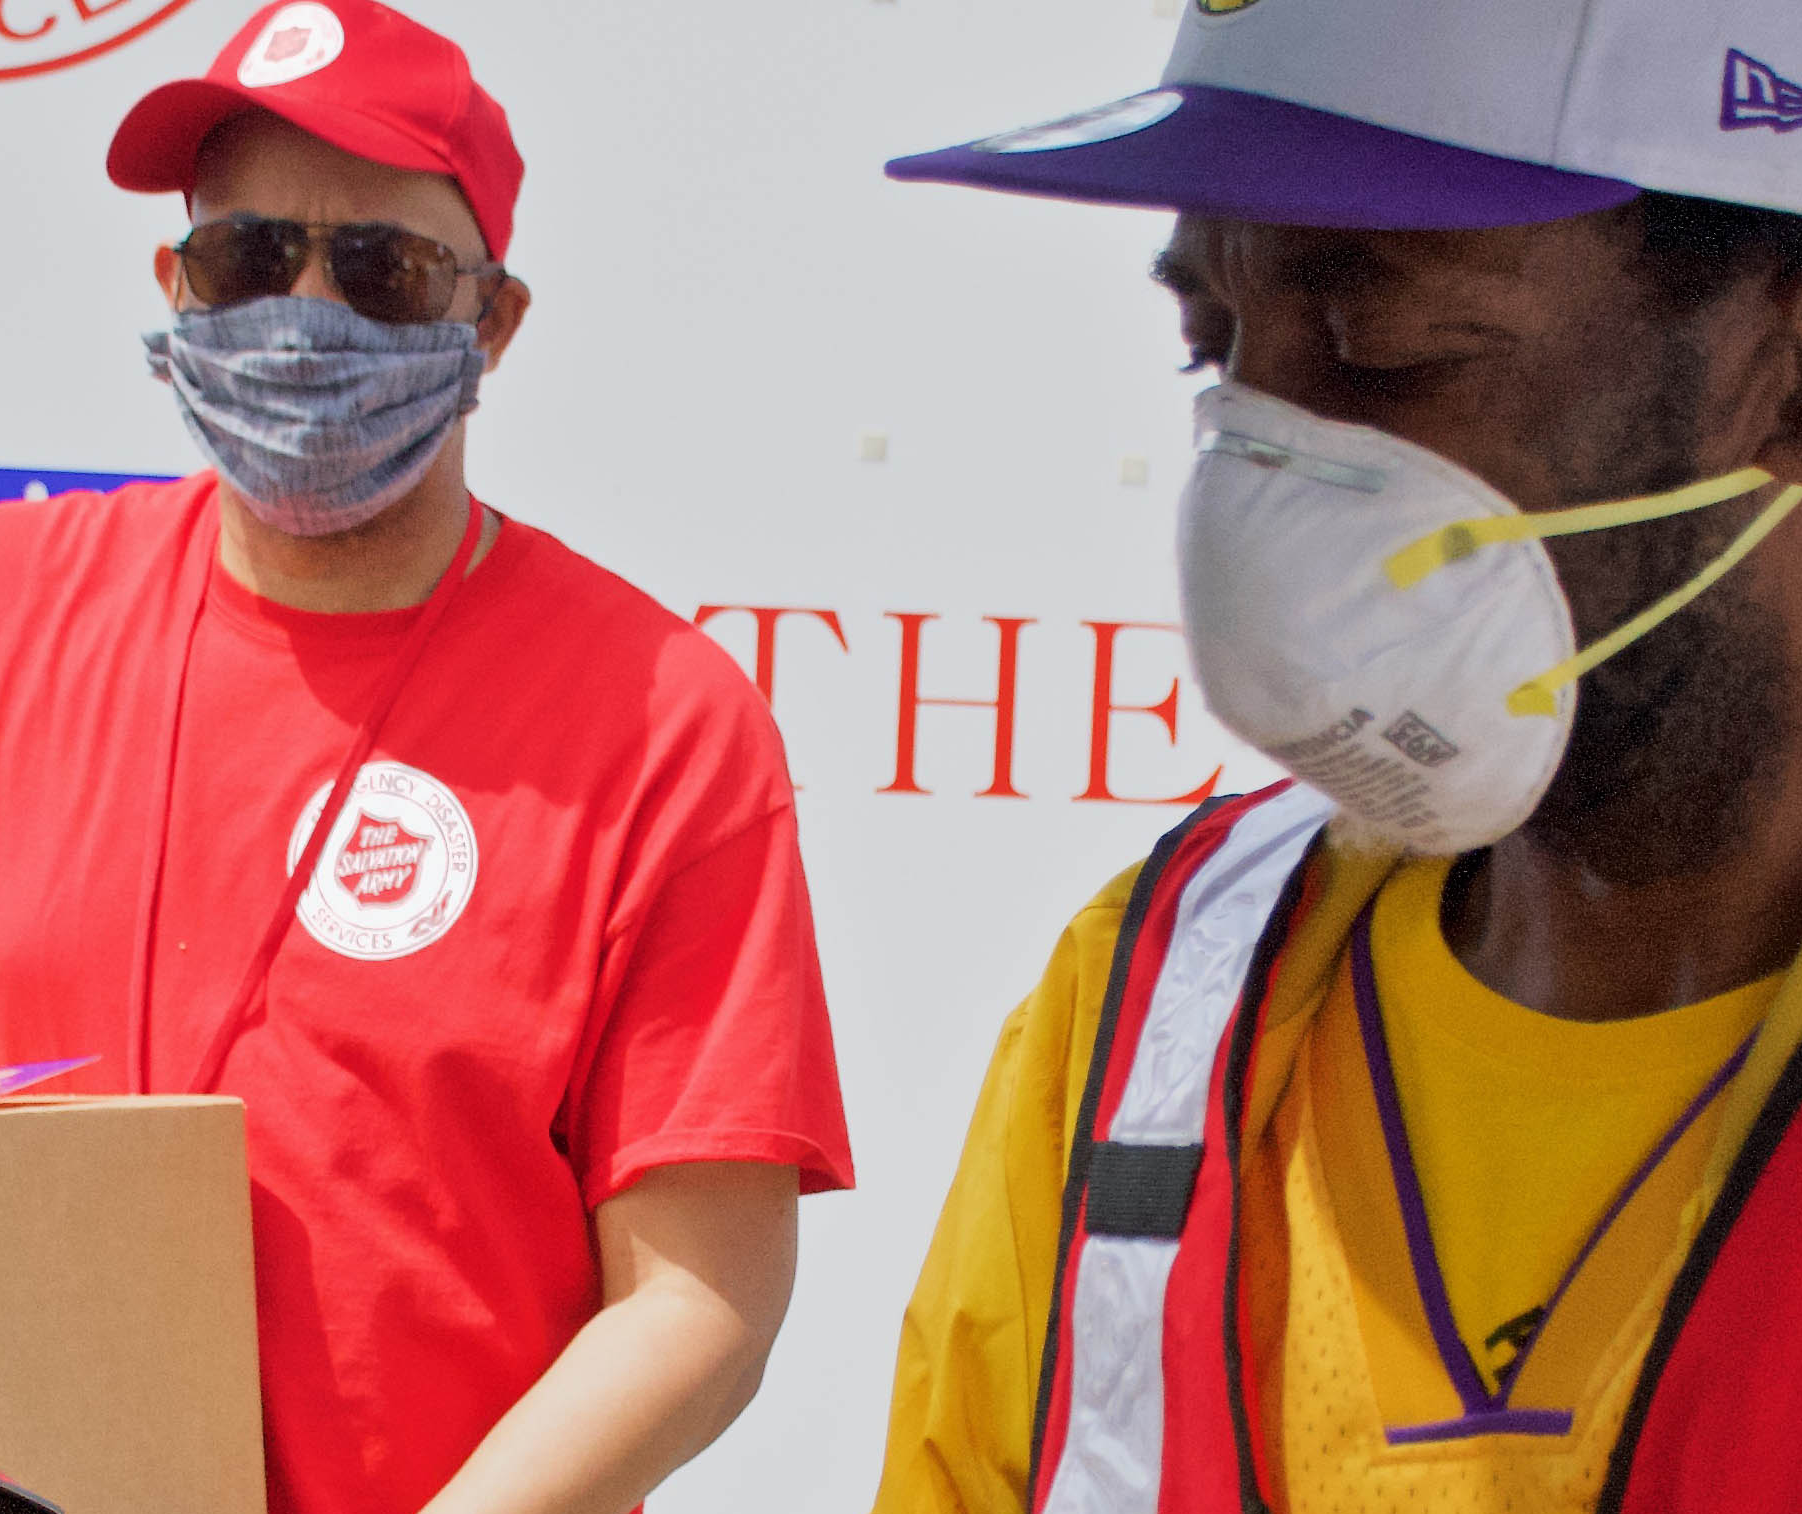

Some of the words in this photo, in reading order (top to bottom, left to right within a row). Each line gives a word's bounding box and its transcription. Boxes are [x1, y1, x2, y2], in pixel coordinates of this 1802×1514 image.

[693, 603, 1225, 806] THE
[357, 824, 399, 849] THE
[353, 864, 414, 897] ARMY
